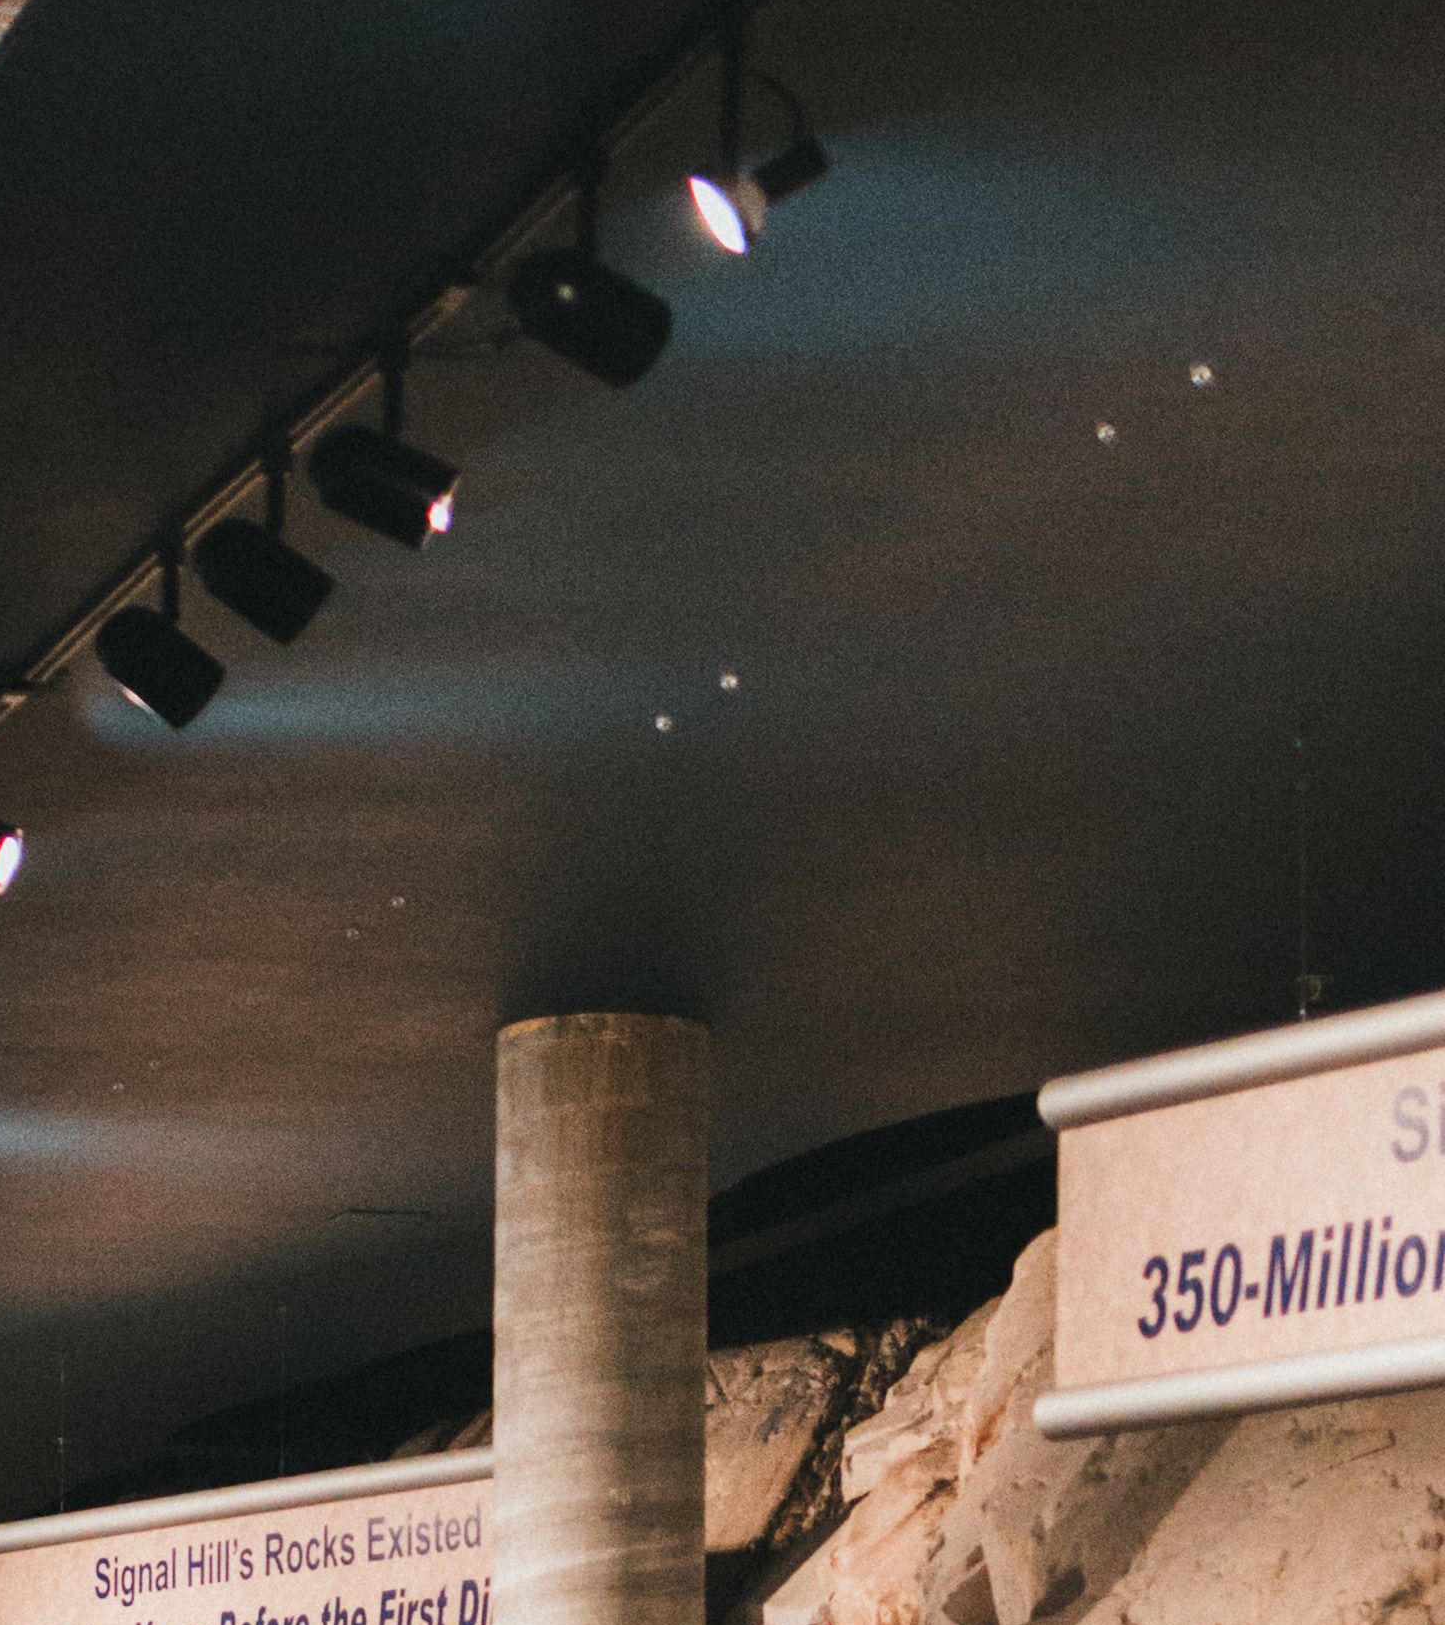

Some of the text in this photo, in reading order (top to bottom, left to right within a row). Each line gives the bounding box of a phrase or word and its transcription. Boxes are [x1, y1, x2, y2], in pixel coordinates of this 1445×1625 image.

[1139, 1216, 1445, 1339] 350-Millio
[94, 1502, 483, 1607] Signal Hill's Rocks Existed
